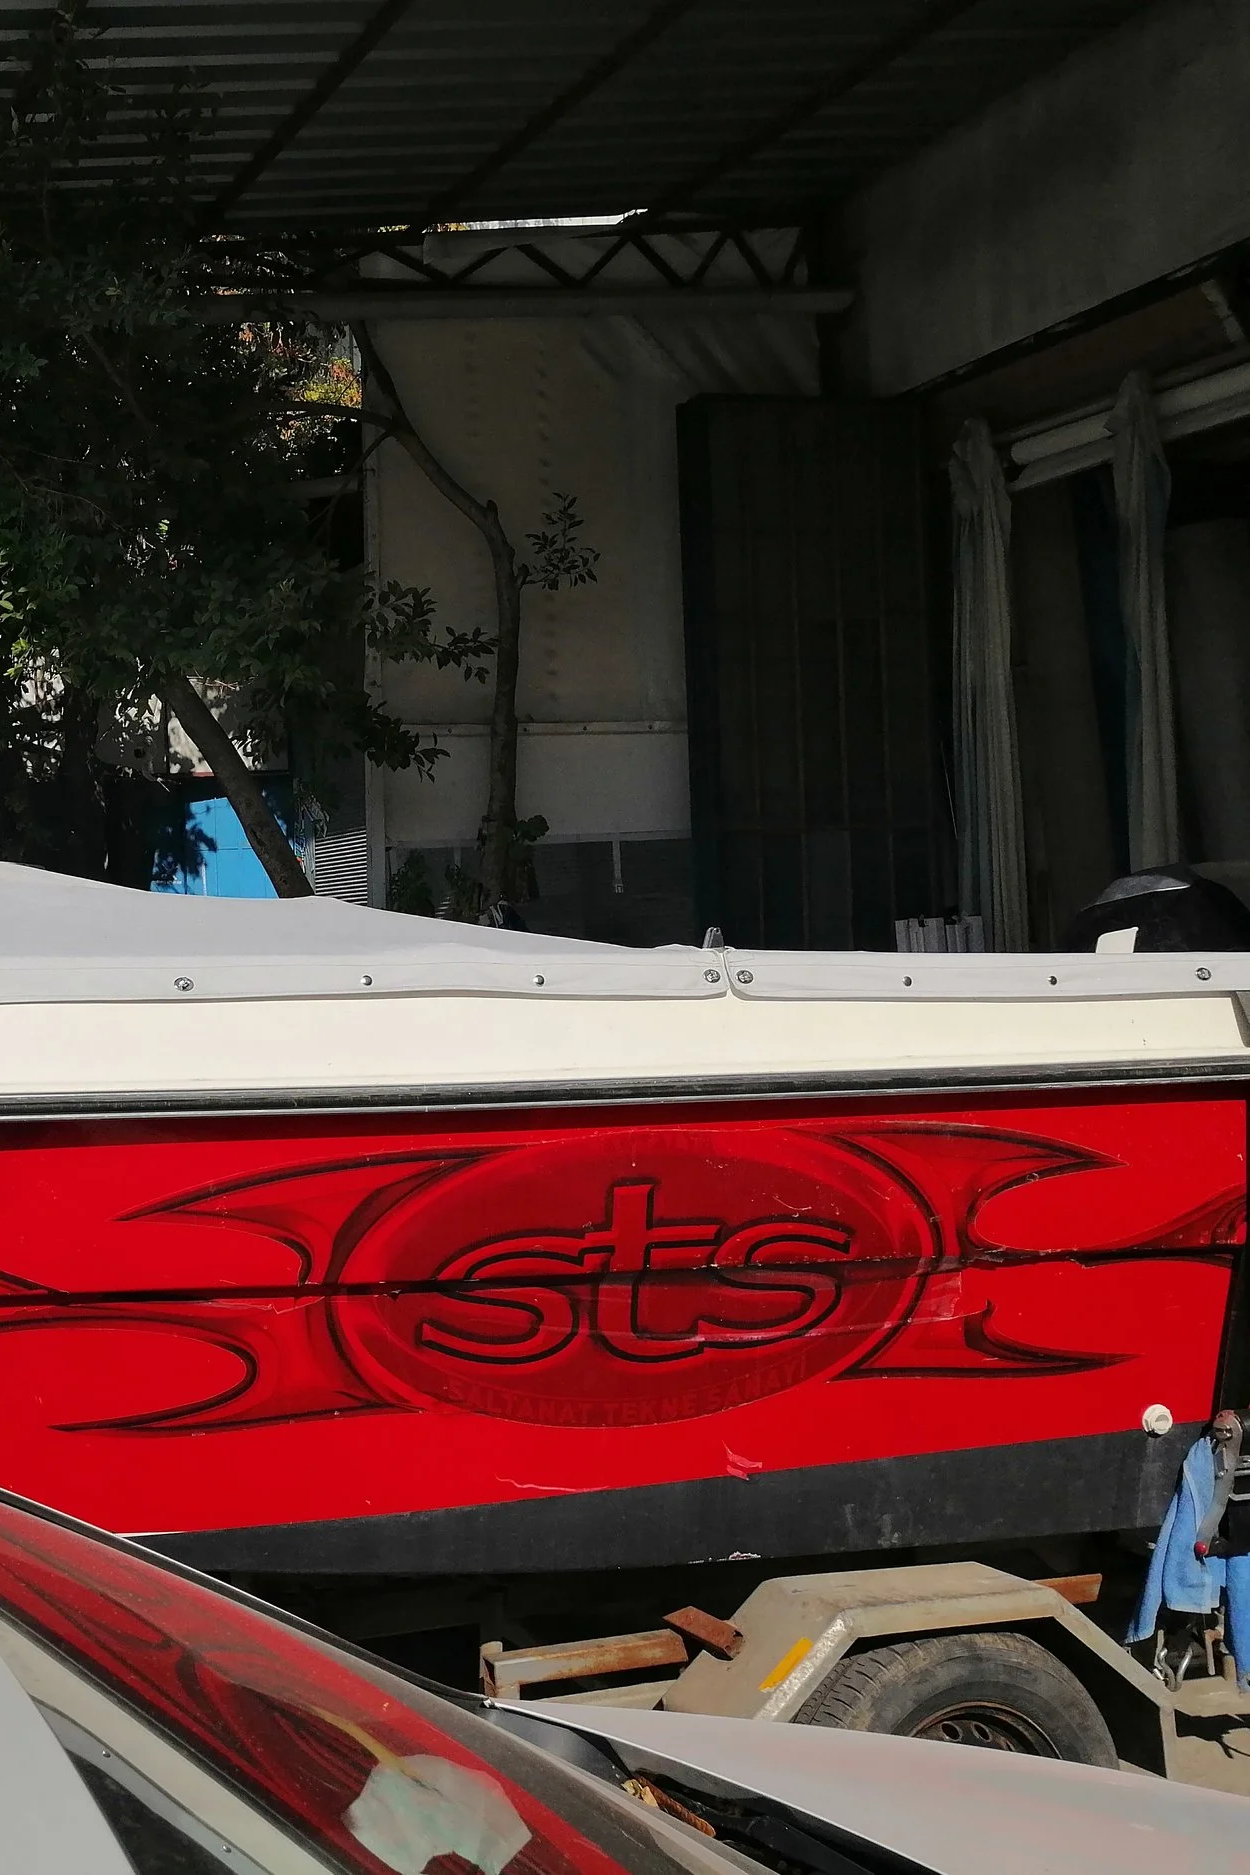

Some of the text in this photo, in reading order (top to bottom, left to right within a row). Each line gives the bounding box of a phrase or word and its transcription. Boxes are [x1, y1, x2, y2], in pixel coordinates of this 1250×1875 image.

[418, 1180, 854, 1364] sts
[448, 1375, 594, 1425] SALTANAT
[603, 1390, 698, 1424] TEKNE
